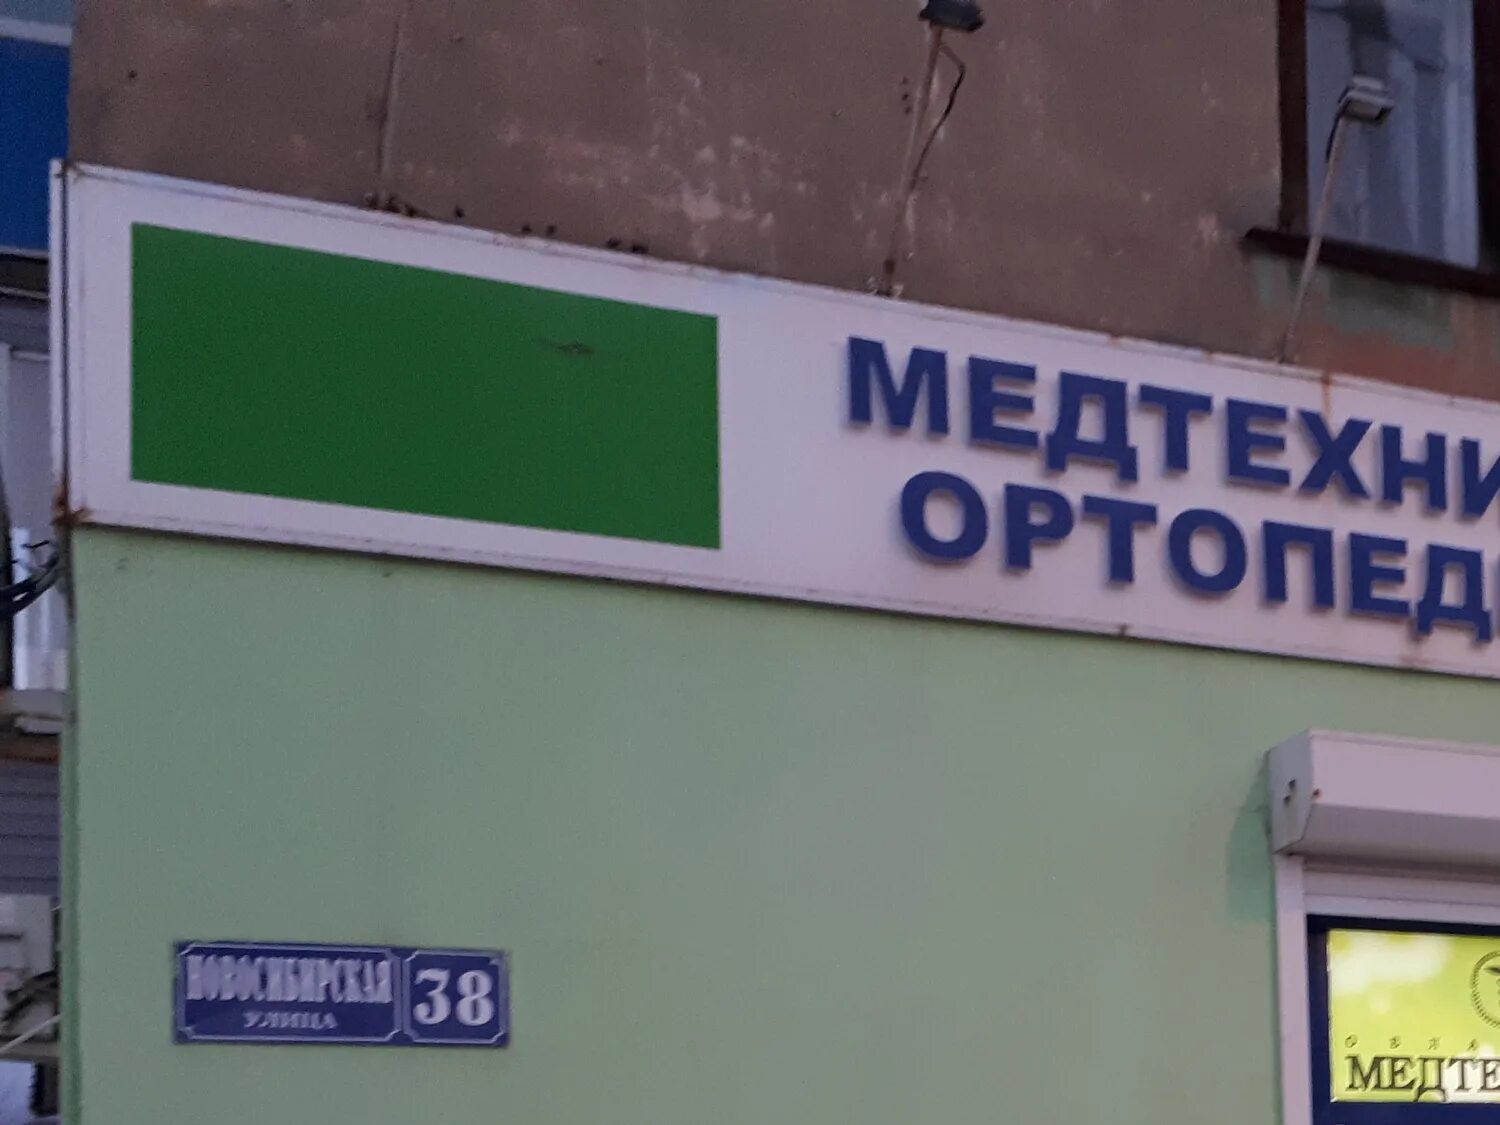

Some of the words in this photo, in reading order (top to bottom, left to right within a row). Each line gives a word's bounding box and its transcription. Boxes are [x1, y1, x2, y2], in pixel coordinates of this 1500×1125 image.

[186, 954, 392, 1004] НОВОСИБИРСКАЯ
[413, 968, 494, 1027] 38
[243, 1010, 338, 1031] УЛИЦА
